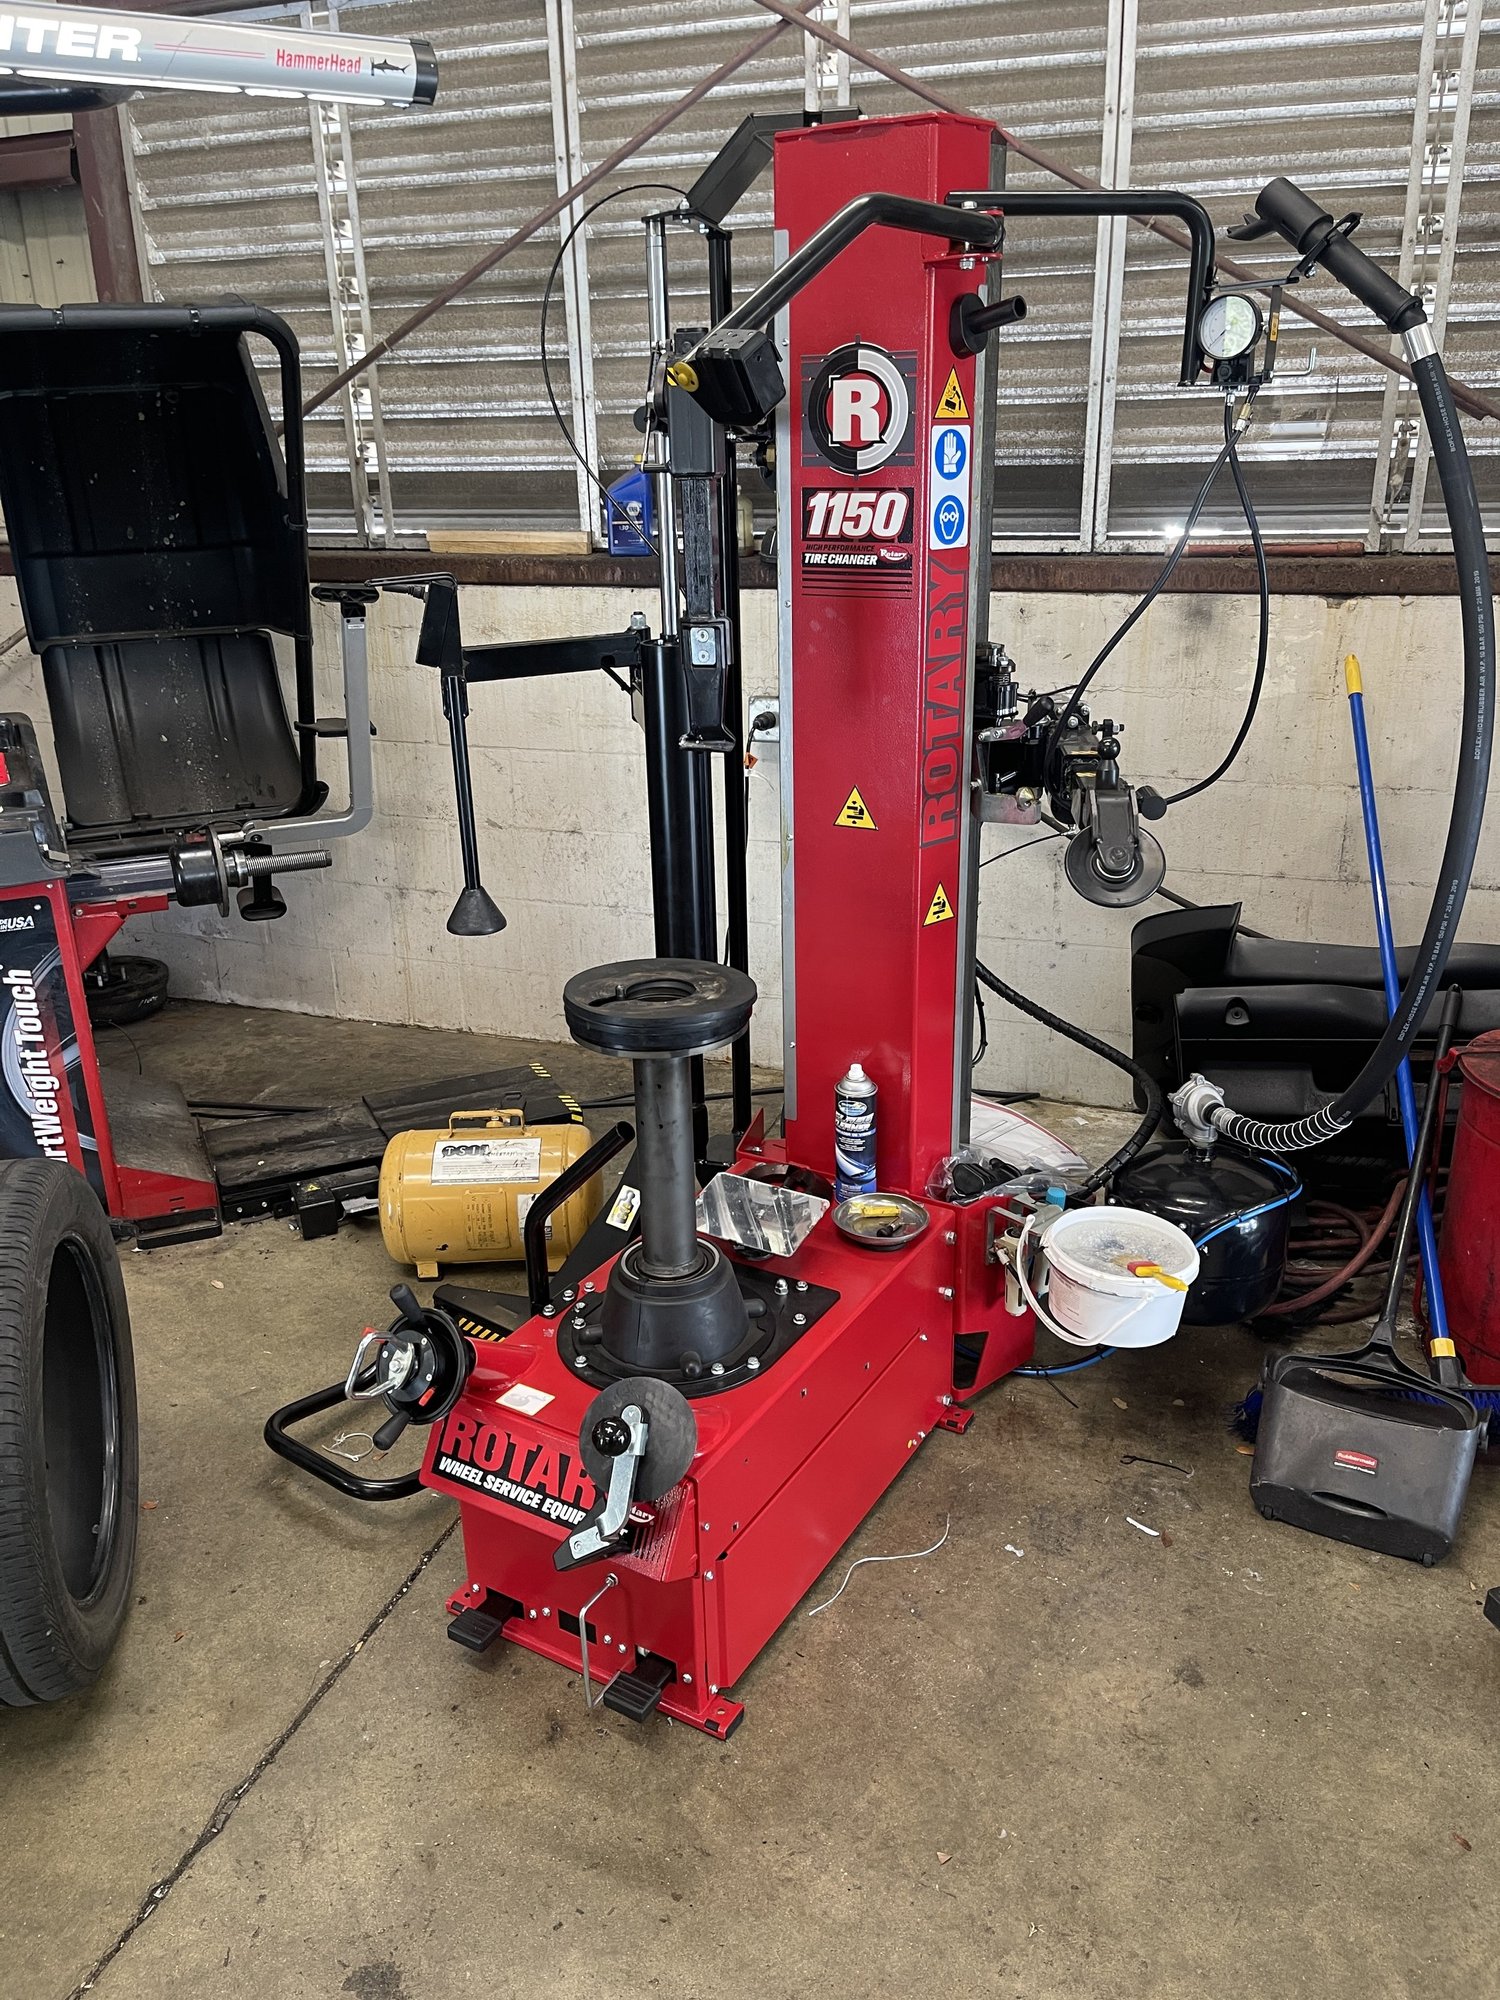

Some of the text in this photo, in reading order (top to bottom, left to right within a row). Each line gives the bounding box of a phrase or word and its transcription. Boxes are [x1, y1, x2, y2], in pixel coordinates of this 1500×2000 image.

[276, 48, 361, 74] HammerHead
[831, 378, 887, 445] R
[808, 491, 909, 539] 1150
[804, 553, 878, 566] TIRE CHANGER
[805, 543, 875, 552] HIGH PERFORMANCE
[879, 548, 908, 561] Rotary
[921, 556, 966, 844] ROTARY
[1478, 688, 1486, 714] RUBBER
[8, 915, 35, 928] USA
[3, 969, 68, 1163] rtWeight Touch
[440, 1413, 597, 1511] ROTAR
[438, 1456, 587, 1525] WHEEL SERVICE EQUIP
[631, 1505, 656, 1520] tary
